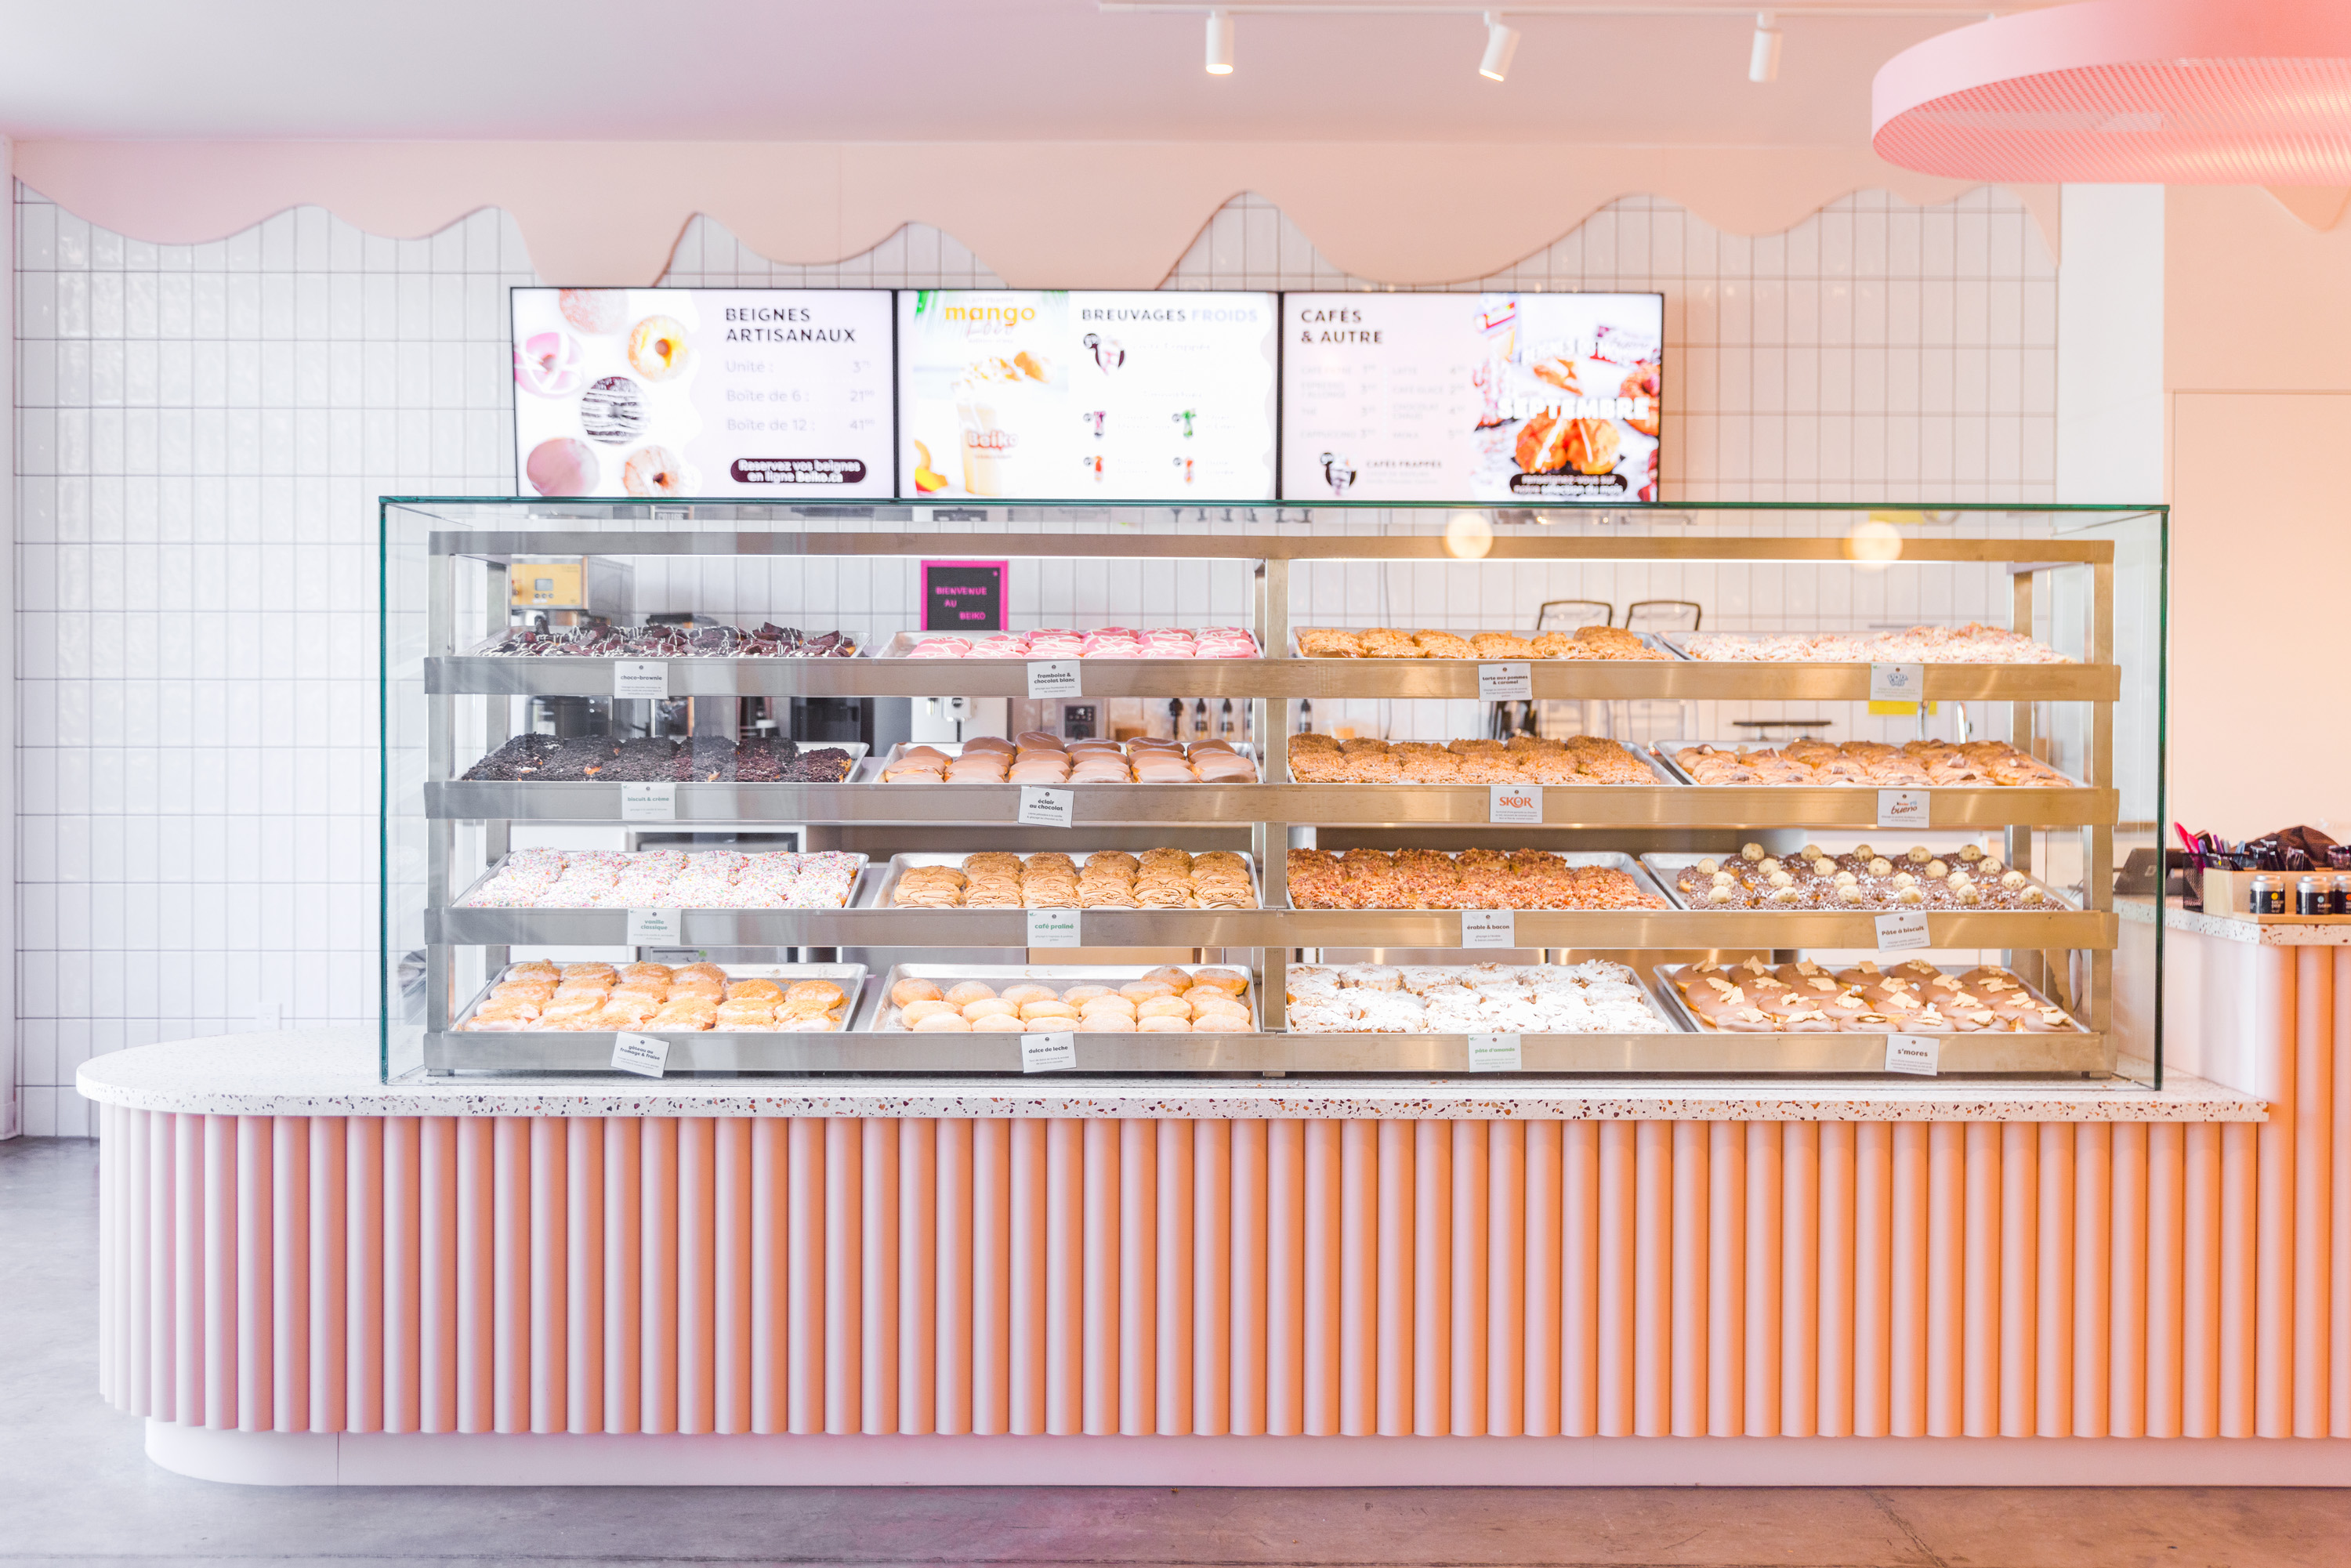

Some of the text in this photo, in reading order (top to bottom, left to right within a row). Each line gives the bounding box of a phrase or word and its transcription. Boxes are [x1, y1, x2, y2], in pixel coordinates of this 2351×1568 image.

[726, 308, 810, 322] BEIGNES
[944, 306, 1037, 328] mango
[1081, 308, 1258, 322] BREUVAGES FROIDS
[1300, 305, 1362, 324] CAFÉS
[726, 328, 856, 342] ARTISANAUX
[1301, 329, 1384, 344] & AUTRE
[726, 360, 766, 373] Unité
[726, 389, 765, 402] Boîte
[769, 389, 788, 402] de
[792, 390, 802, 402] 6
[1497, 397, 1650, 419] SEPTEMBRE
[727, 418, 766, 432] Boîte
[770, 418, 788, 431] de
[792, 419, 807, 431] 12
[813, 459, 861, 475] beignes
[747, 472, 764, 482] en
[764, 470, 795, 483] ligne
[935, 586, 987, 596] BIENVENUE
[959, 611, 986, 620] BEIKO
[1499, 796, 1534, 809] SKOR
[1890, 805, 1918, 815] bueno
[620, 1047, 641, 1056] fromage
[1897, 1048, 1929, 1057] s'mores
